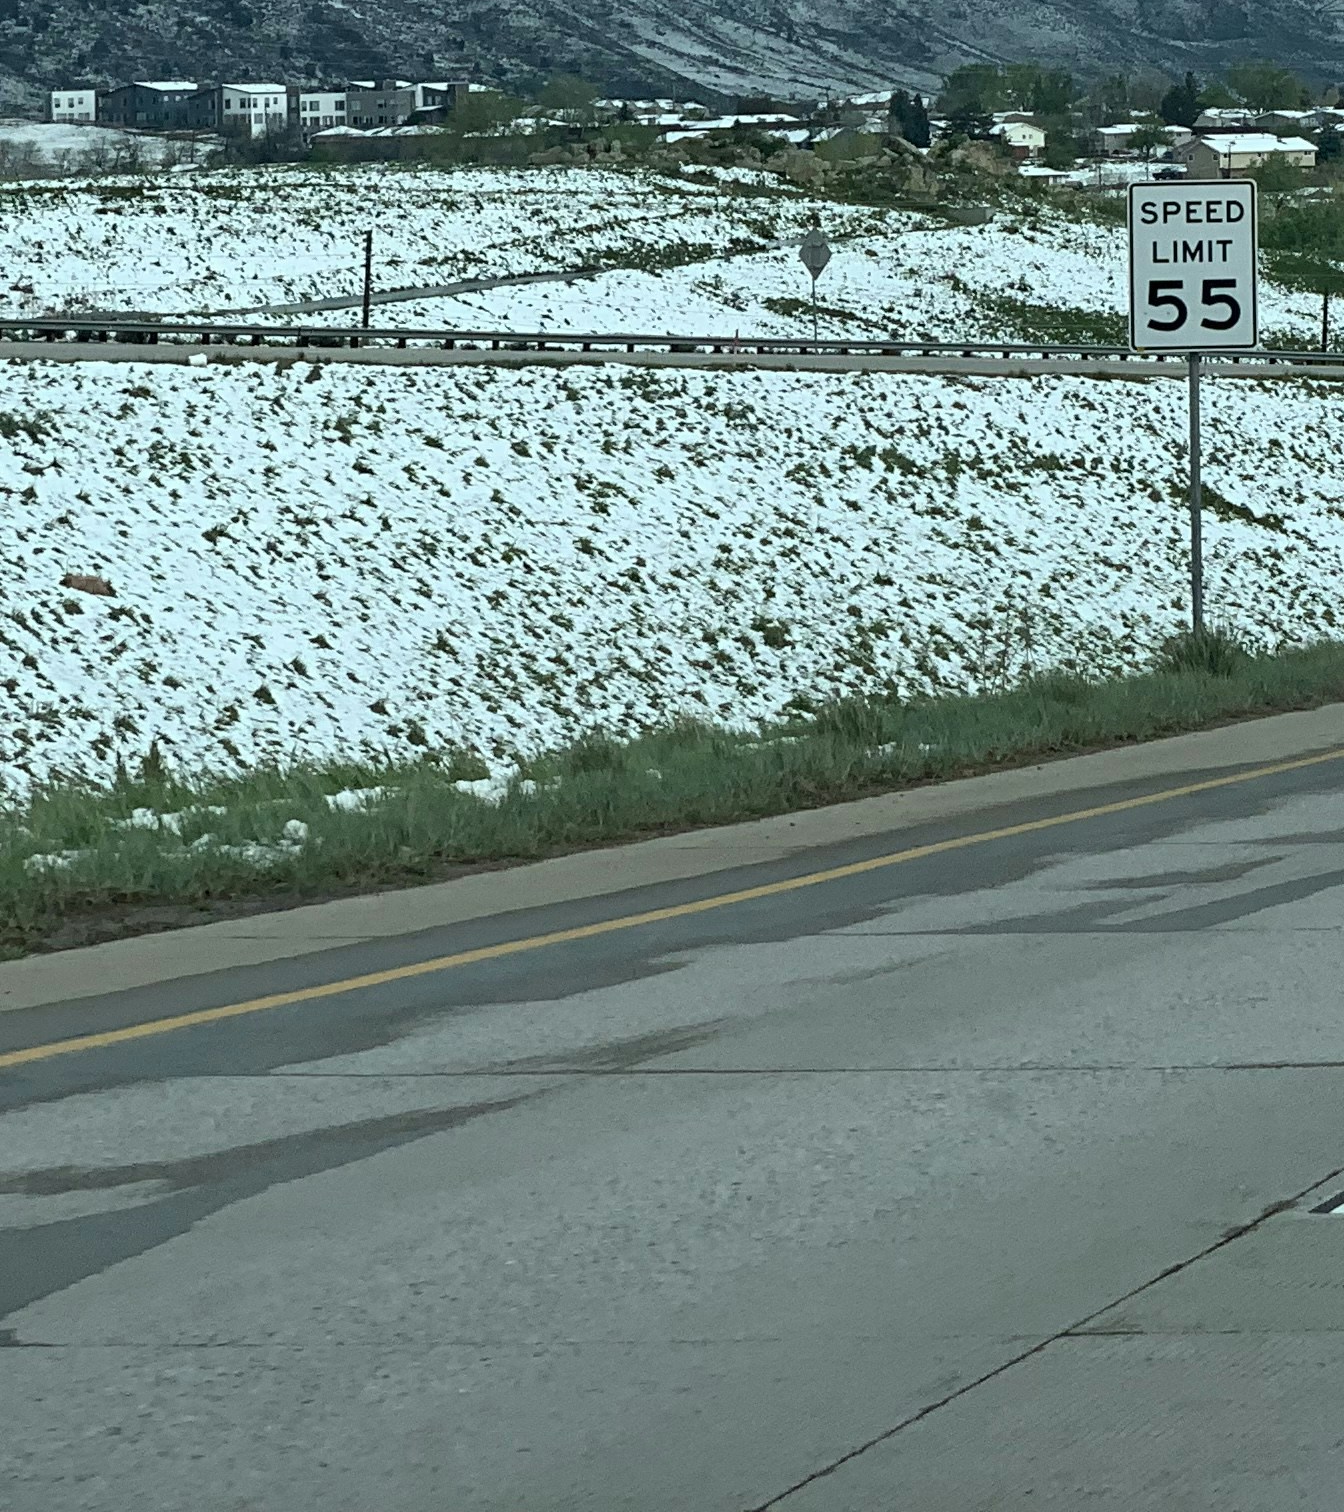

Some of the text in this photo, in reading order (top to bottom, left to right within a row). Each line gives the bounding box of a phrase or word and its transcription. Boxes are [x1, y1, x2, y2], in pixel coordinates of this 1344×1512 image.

[1141, 200, 1245, 224] SPEED
[1152, 240, 1233, 263] LIMIT
[1147, 279, 1241, 331] 55
